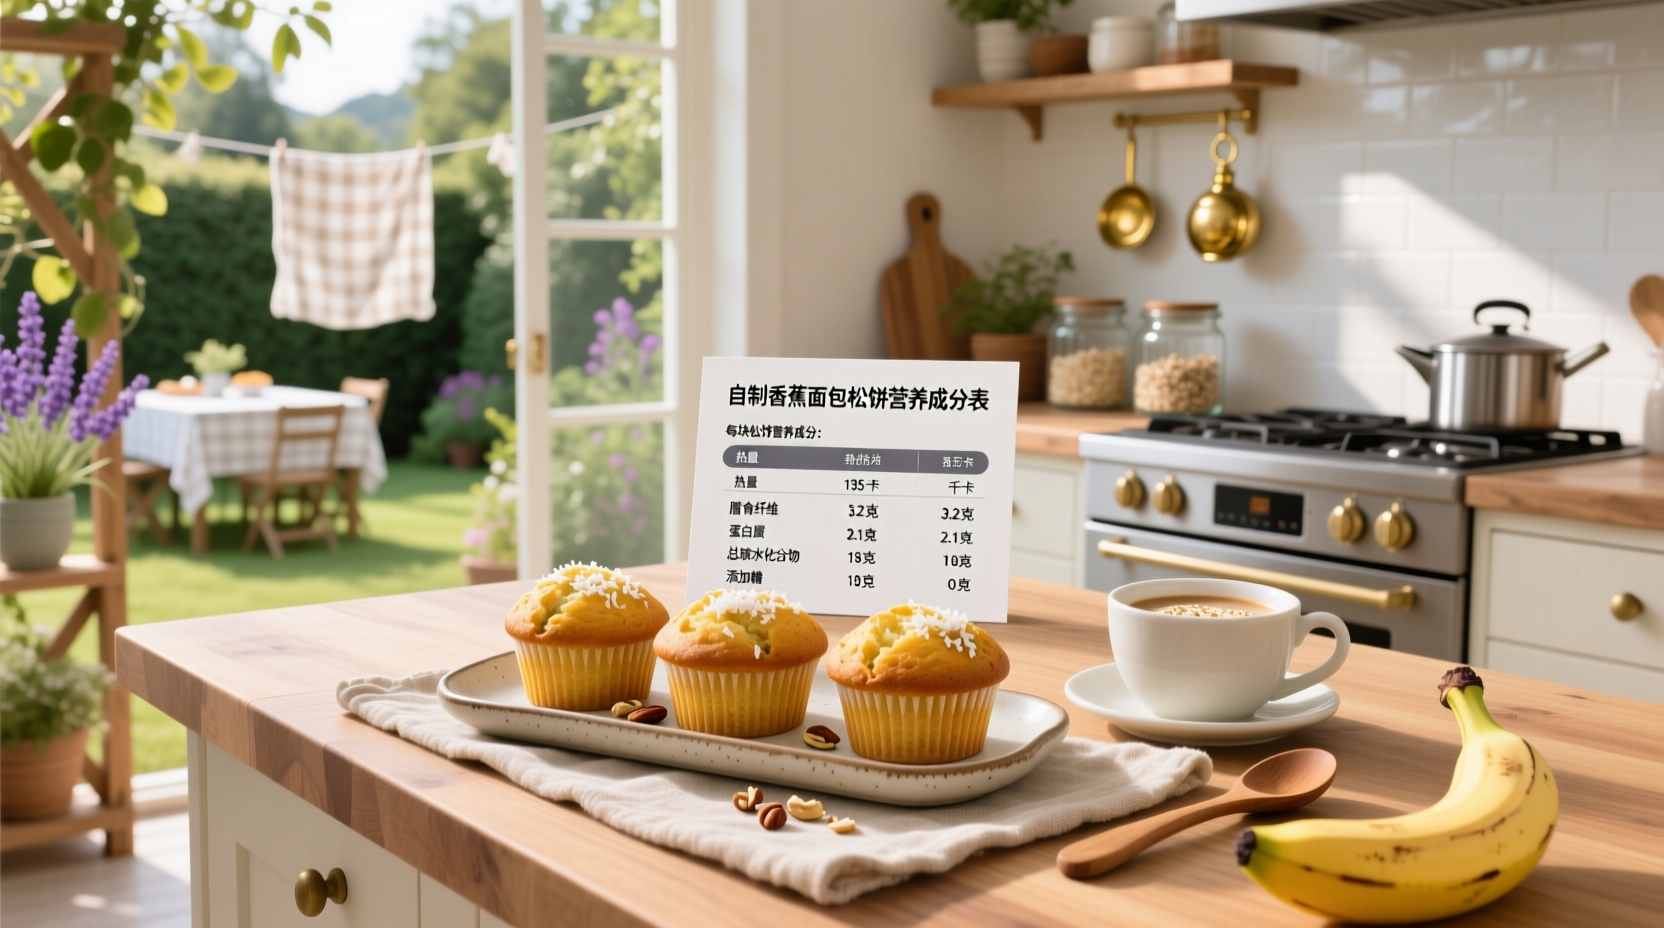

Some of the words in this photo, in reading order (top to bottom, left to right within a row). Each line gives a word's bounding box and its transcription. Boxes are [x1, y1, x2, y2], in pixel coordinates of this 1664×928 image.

[730, 384, 990, 411] 自制香蕉面包松饼营养成分表
[948, 480, 975, 495] 千卡
[941, 507, 975, 522] 3.2克
[846, 528, 877, 542] 2.1克
[940, 530, 974, 545] 2.1克
[947, 578, 971, 592] 0克
